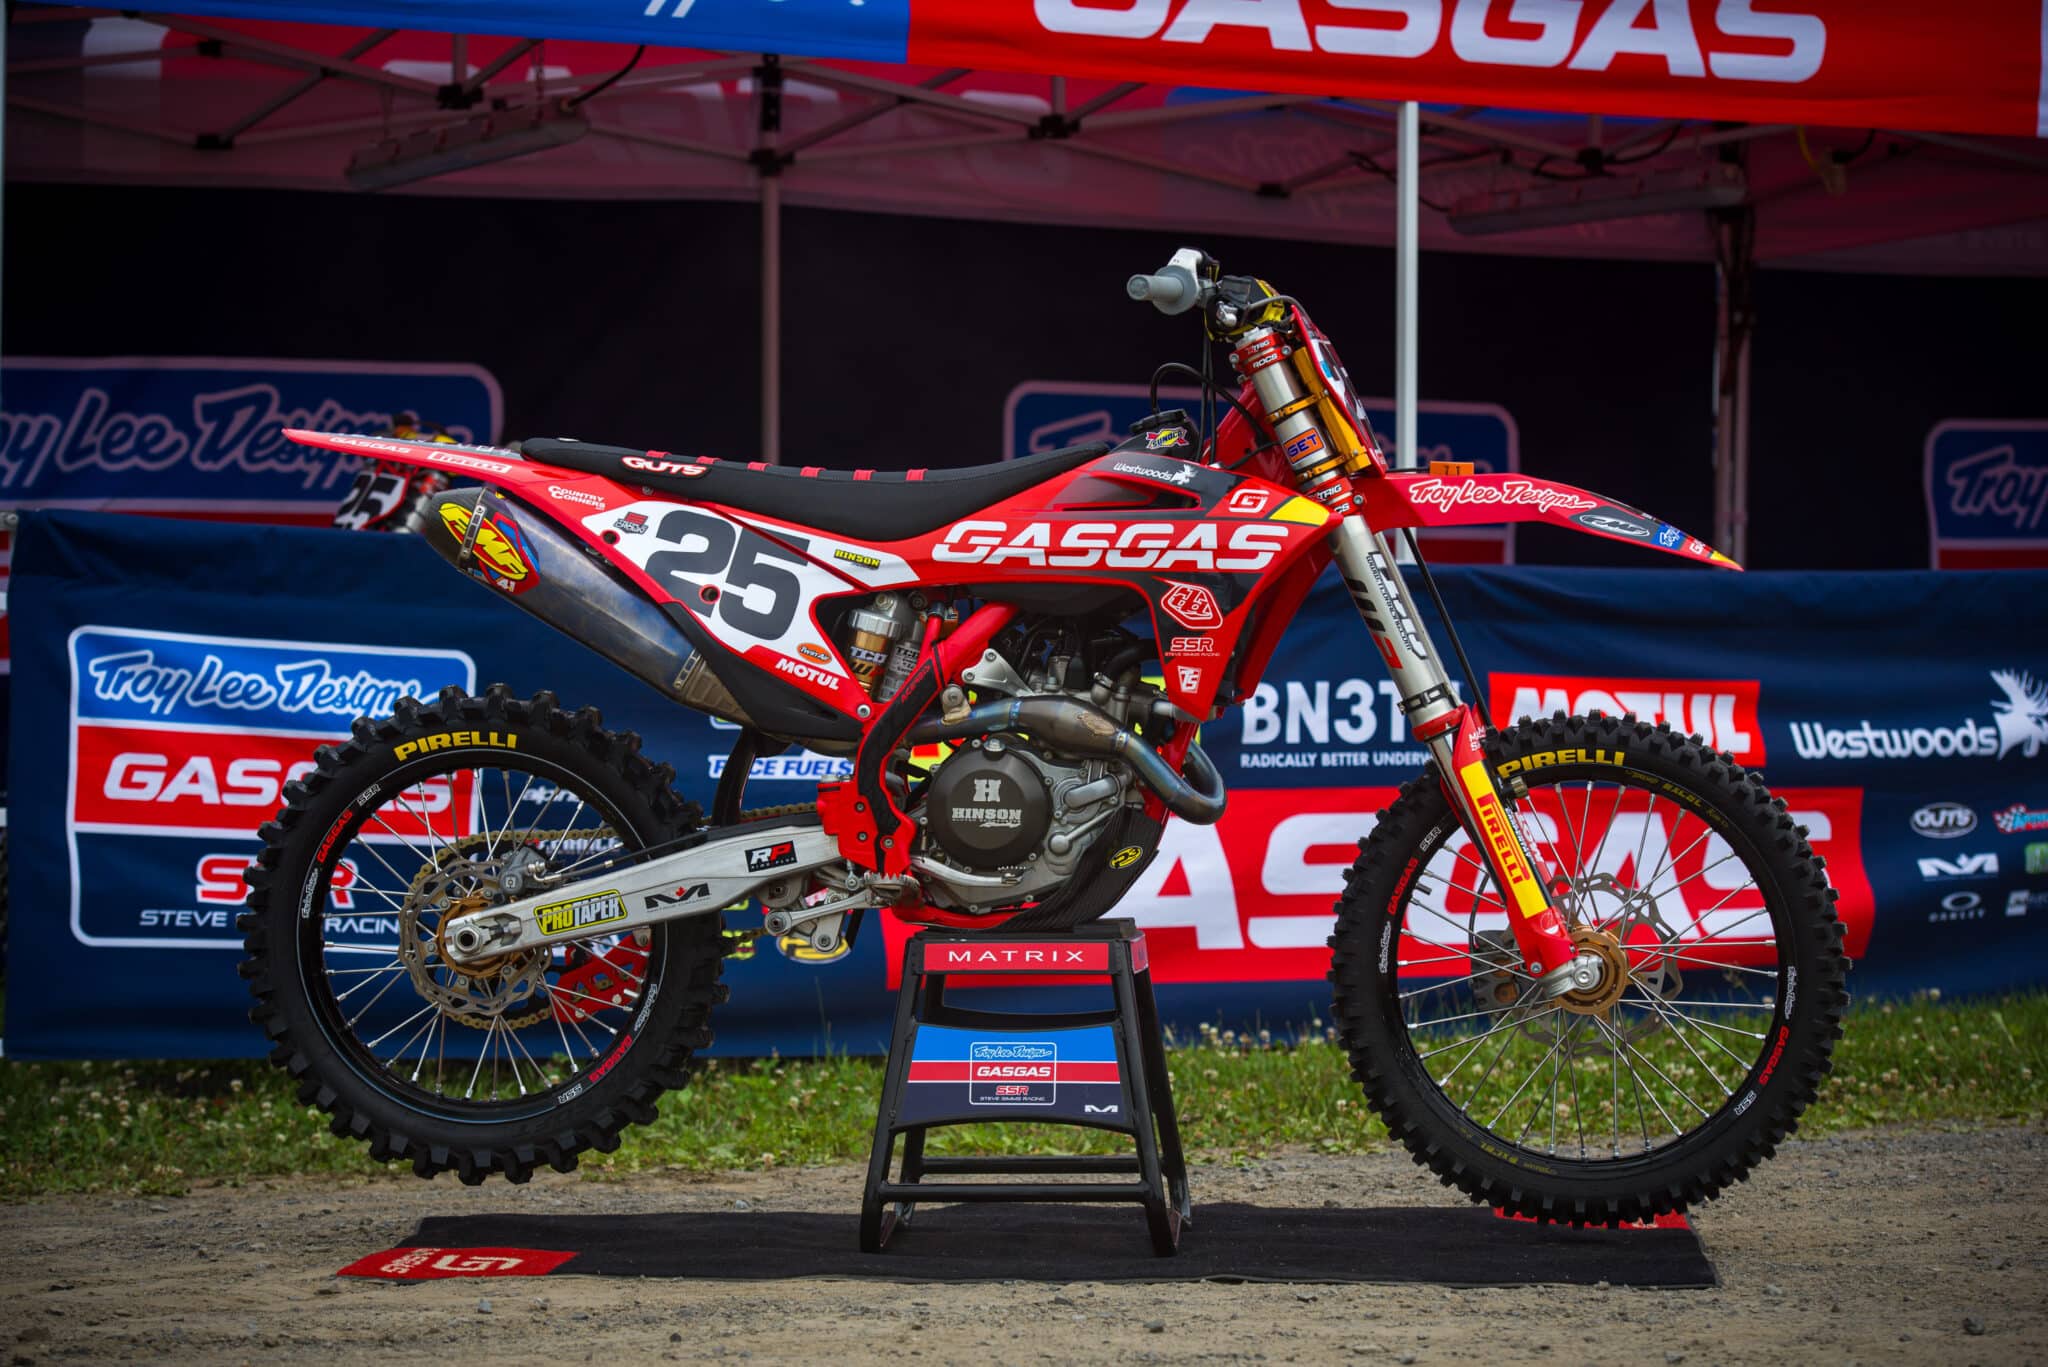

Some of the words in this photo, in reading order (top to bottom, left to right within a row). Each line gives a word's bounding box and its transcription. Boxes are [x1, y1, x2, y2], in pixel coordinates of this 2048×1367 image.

[54, 387, 190, 472] Lee
[621, 455, 707, 476] GUTS
[1113, 462, 1173, 482] Westwoods
[548, 485, 604, 502] COUNTRY
[551, 490, 606, 508] CORNERS
[1408, 479, 1464, 513] Troy
[1457, 479, 1502, 505] Lee
[1501, 481, 1598, 512] Designs
[834, 548, 881, 568] HINSON
[931, 520, 1289, 571] GASGAS
[645, 510, 811, 641] 25
[1171, 637, 1214, 652] SSR
[88, 649, 189, 715] Troy
[186, 655, 277, 710] Lee
[774, 657, 840, 692] MOTUL
[1241, 678, 1464, 746] BN3T
[394, 730, 517, 761] PIRELLI
[1789, 718, 1999, 760] Westwoods
[713, 759, 776, 777] RCE
[782, 760, 854, 777] FUELS
[1240, 752, 1318, 769] RADICALLY
[1320, 752, 1371, 768] BETTER
[1372, 751, 1433, 768] UNDERW
[1497, 748, 1625, 779] PIRELLI
[103, 751, 463, 816] GASS
[357, 783, 381, 807] SSR
[952, 807, 1022, 820] HINSON
[1914, 807, 1971, 828] GUTS
[316, 809, 353, 863] GASGAS
[1419, 826, 1443, 852] SSR
[1475, 791, 1532, 885] PIRELLI
[196, 853, 359, 910] SR
[1100, 808, 1833, 951] ASGAS
[1387, 856, 1420, 916] GASGAS
[139, 909, 228, 928] STEVE
[323, 916, 401, 935] RACIN
[948, 950, 1085, 962] MATRIX
[1757, 1025, 1791, 1086] GASGAS
[976, 1066, 1052, 1077] GASGAS
[995, 1085, 1030, 1096] SSR
[1733, 1089, 1758, 1116] SSR
